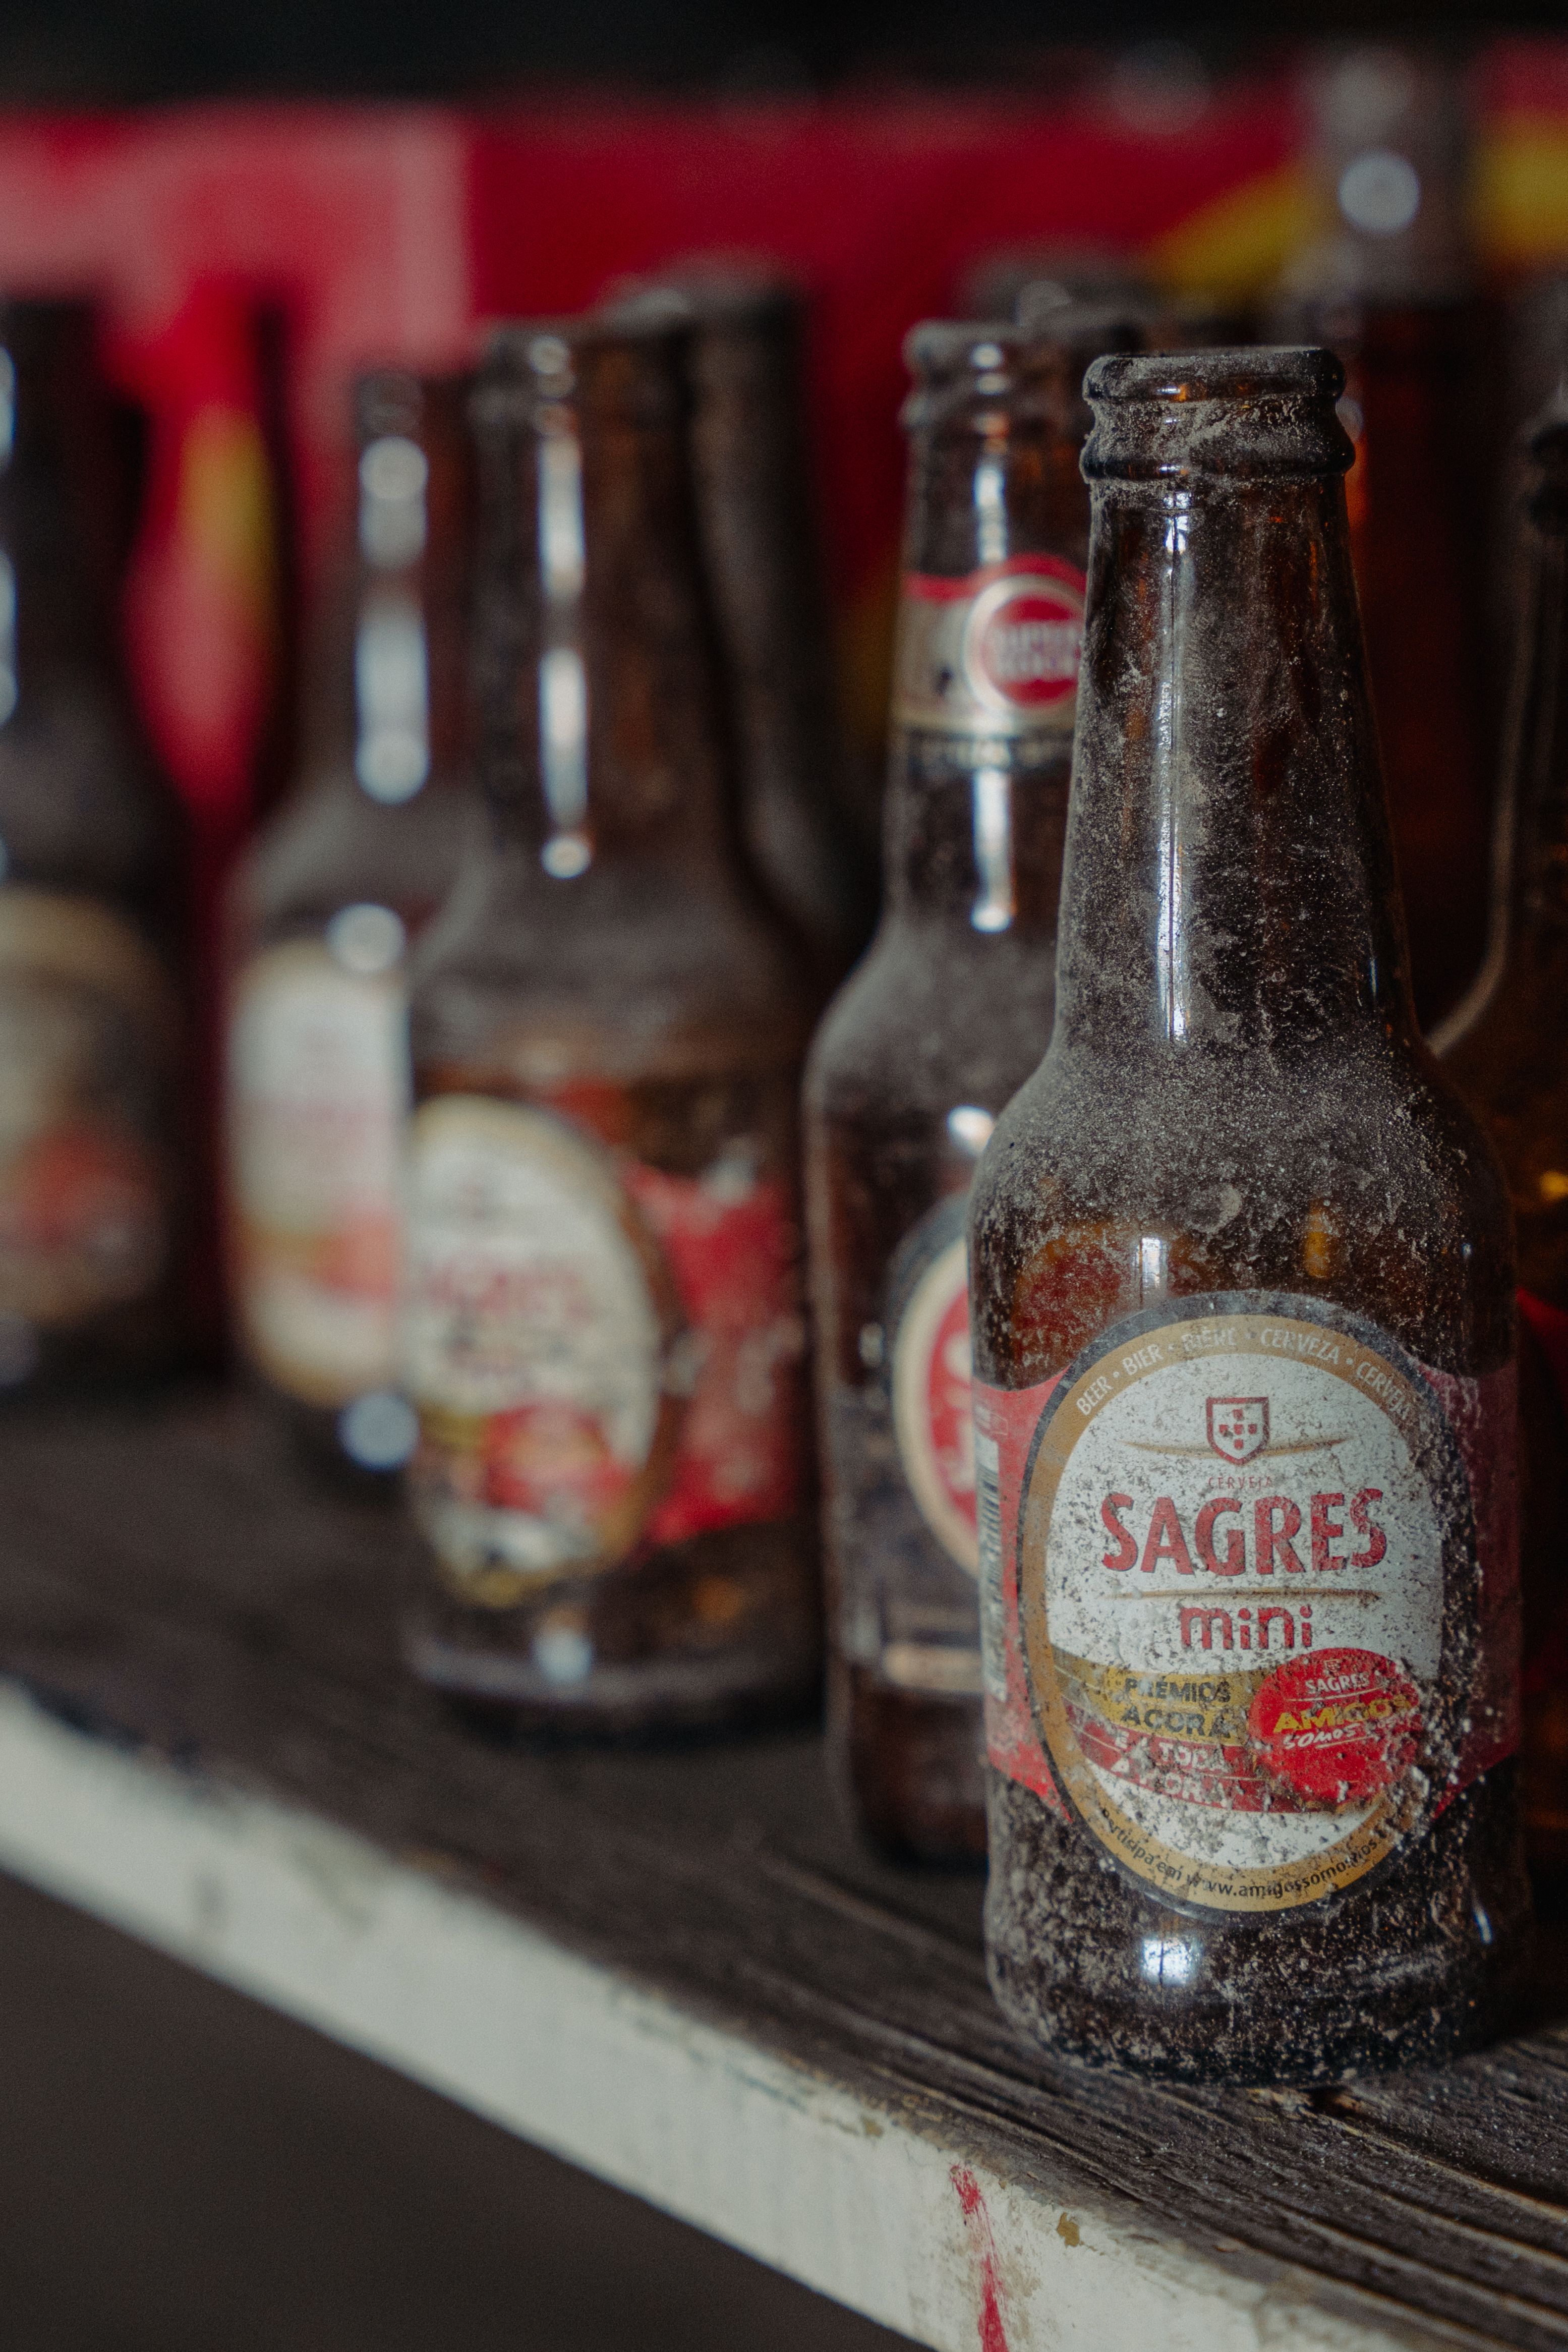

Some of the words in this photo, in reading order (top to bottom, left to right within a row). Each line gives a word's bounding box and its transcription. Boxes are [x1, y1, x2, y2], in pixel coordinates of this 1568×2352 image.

[1076, 1376, 1113, 1416] BEER
[1122, 1344, 1164, 1376] BIER
[1261, 1328, 1341, 1360] CERVEZA
[1208, 1475, 1273, 1491] CERVEJA
[1100, 1488, 1387, 1576] SAGRES
[1180, 1605, 1313, 1650] mini
[1305, 1673, 1370, 1695] SAGRES
